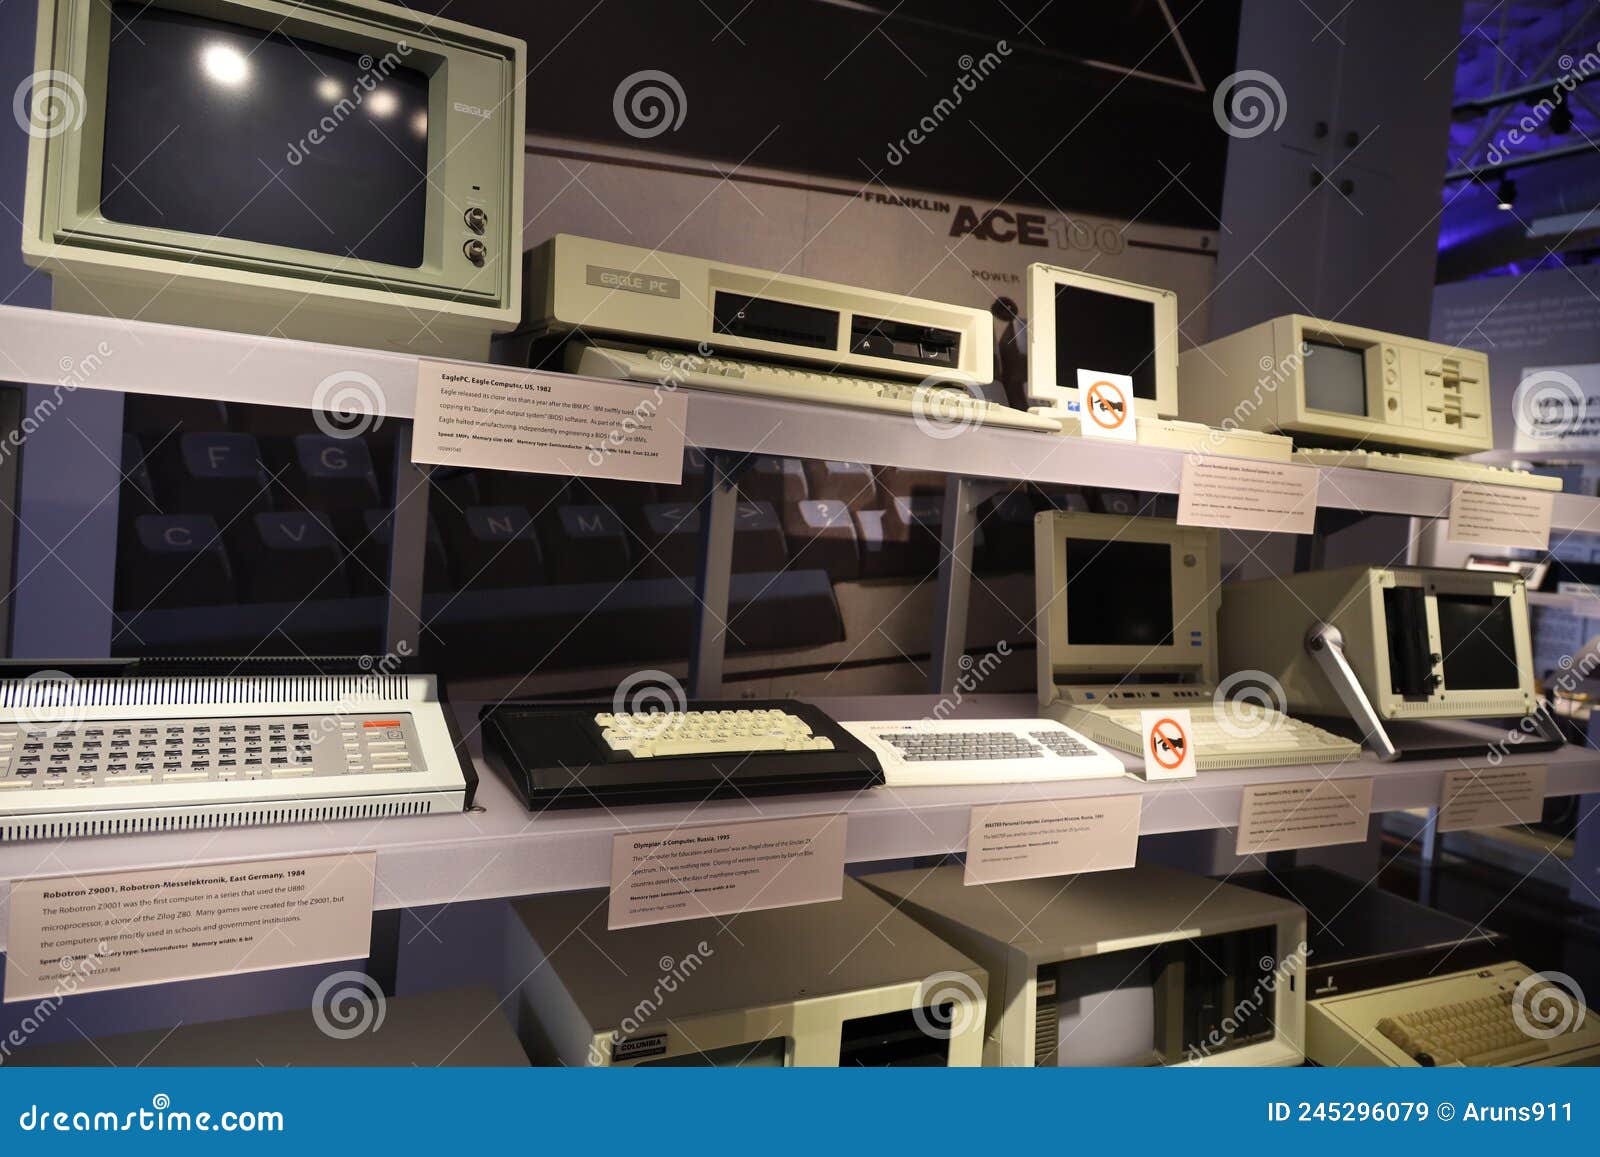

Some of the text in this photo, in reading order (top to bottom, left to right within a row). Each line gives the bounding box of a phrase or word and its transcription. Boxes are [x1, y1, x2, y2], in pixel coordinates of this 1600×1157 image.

[864, 190, 950, 214] FRANKLIN
[949, 205, 1048, 248] ACE
[971, 269, 1020, 283] POWER
[649, 279, 668, 293] PC
[441, 373, 470, 382] EaglePC,
[471, 378, 490, 386] Eagle
[490, 380, 523, 390] Computer,
[440, 388, 456, 396] Eagle
[458, 390, 481, 398] released
[518, 396, 531, 404] than
[440, 403, 462, 412] copying
[438, 416, 455, 424] Eagle
[456, 418, 474, 426] halted
[207, 447, 230, 468] F
[320, 447, 348, 469] G
[164, 527, 193, 546] C
[280, 523, 305, 542] V
[488, 516, 513, 534] N
[577, 515, 603, 531] M
[817, 503, 830, 518] ?
[43, 890, 86, 899] Robotron
[88, 886, 118, 895] Z9001,
[120, 876, 228, 892] Robotron-Messelektronik,
[248, 871, 285, 881] Germany,
[59, 904, 96, 914] Robotron
[98, 902, 121, 910] Z9001
[124, 900, 138, 908] was
[140, 898, 152, 906] the
[154, 897, 168, 905] first
[169, 894, 204, 904] computer
[220, 890, 239, 898] series
[241, 888, 255, 896] that
[274, 886, 286, 894] the
[42, 921, 103, 932] microprocessor,
[111, 917, 132, 926] clone
[156, 912, 176, 921] Zilog
[196, 909, 215, 917] Many
[217, 906, 240, 915] games
[242, 904, 258, 912] were
[260, 902, 285, 910] created
[286, 900, 296, 908] for
[56, 936, 98, 948] computers
[100, 934, 118, 942] were
[120, 931, 144, 941] mostly
[146, 930, 164, 938] used
[174, 925, 201, 934] schools
[202, 922, 216, 931] and
[218, 918, 261, 930] government
[192, 940, 218, 948] Memory
[621, 1039, 661, 1051] COLUMBIA
